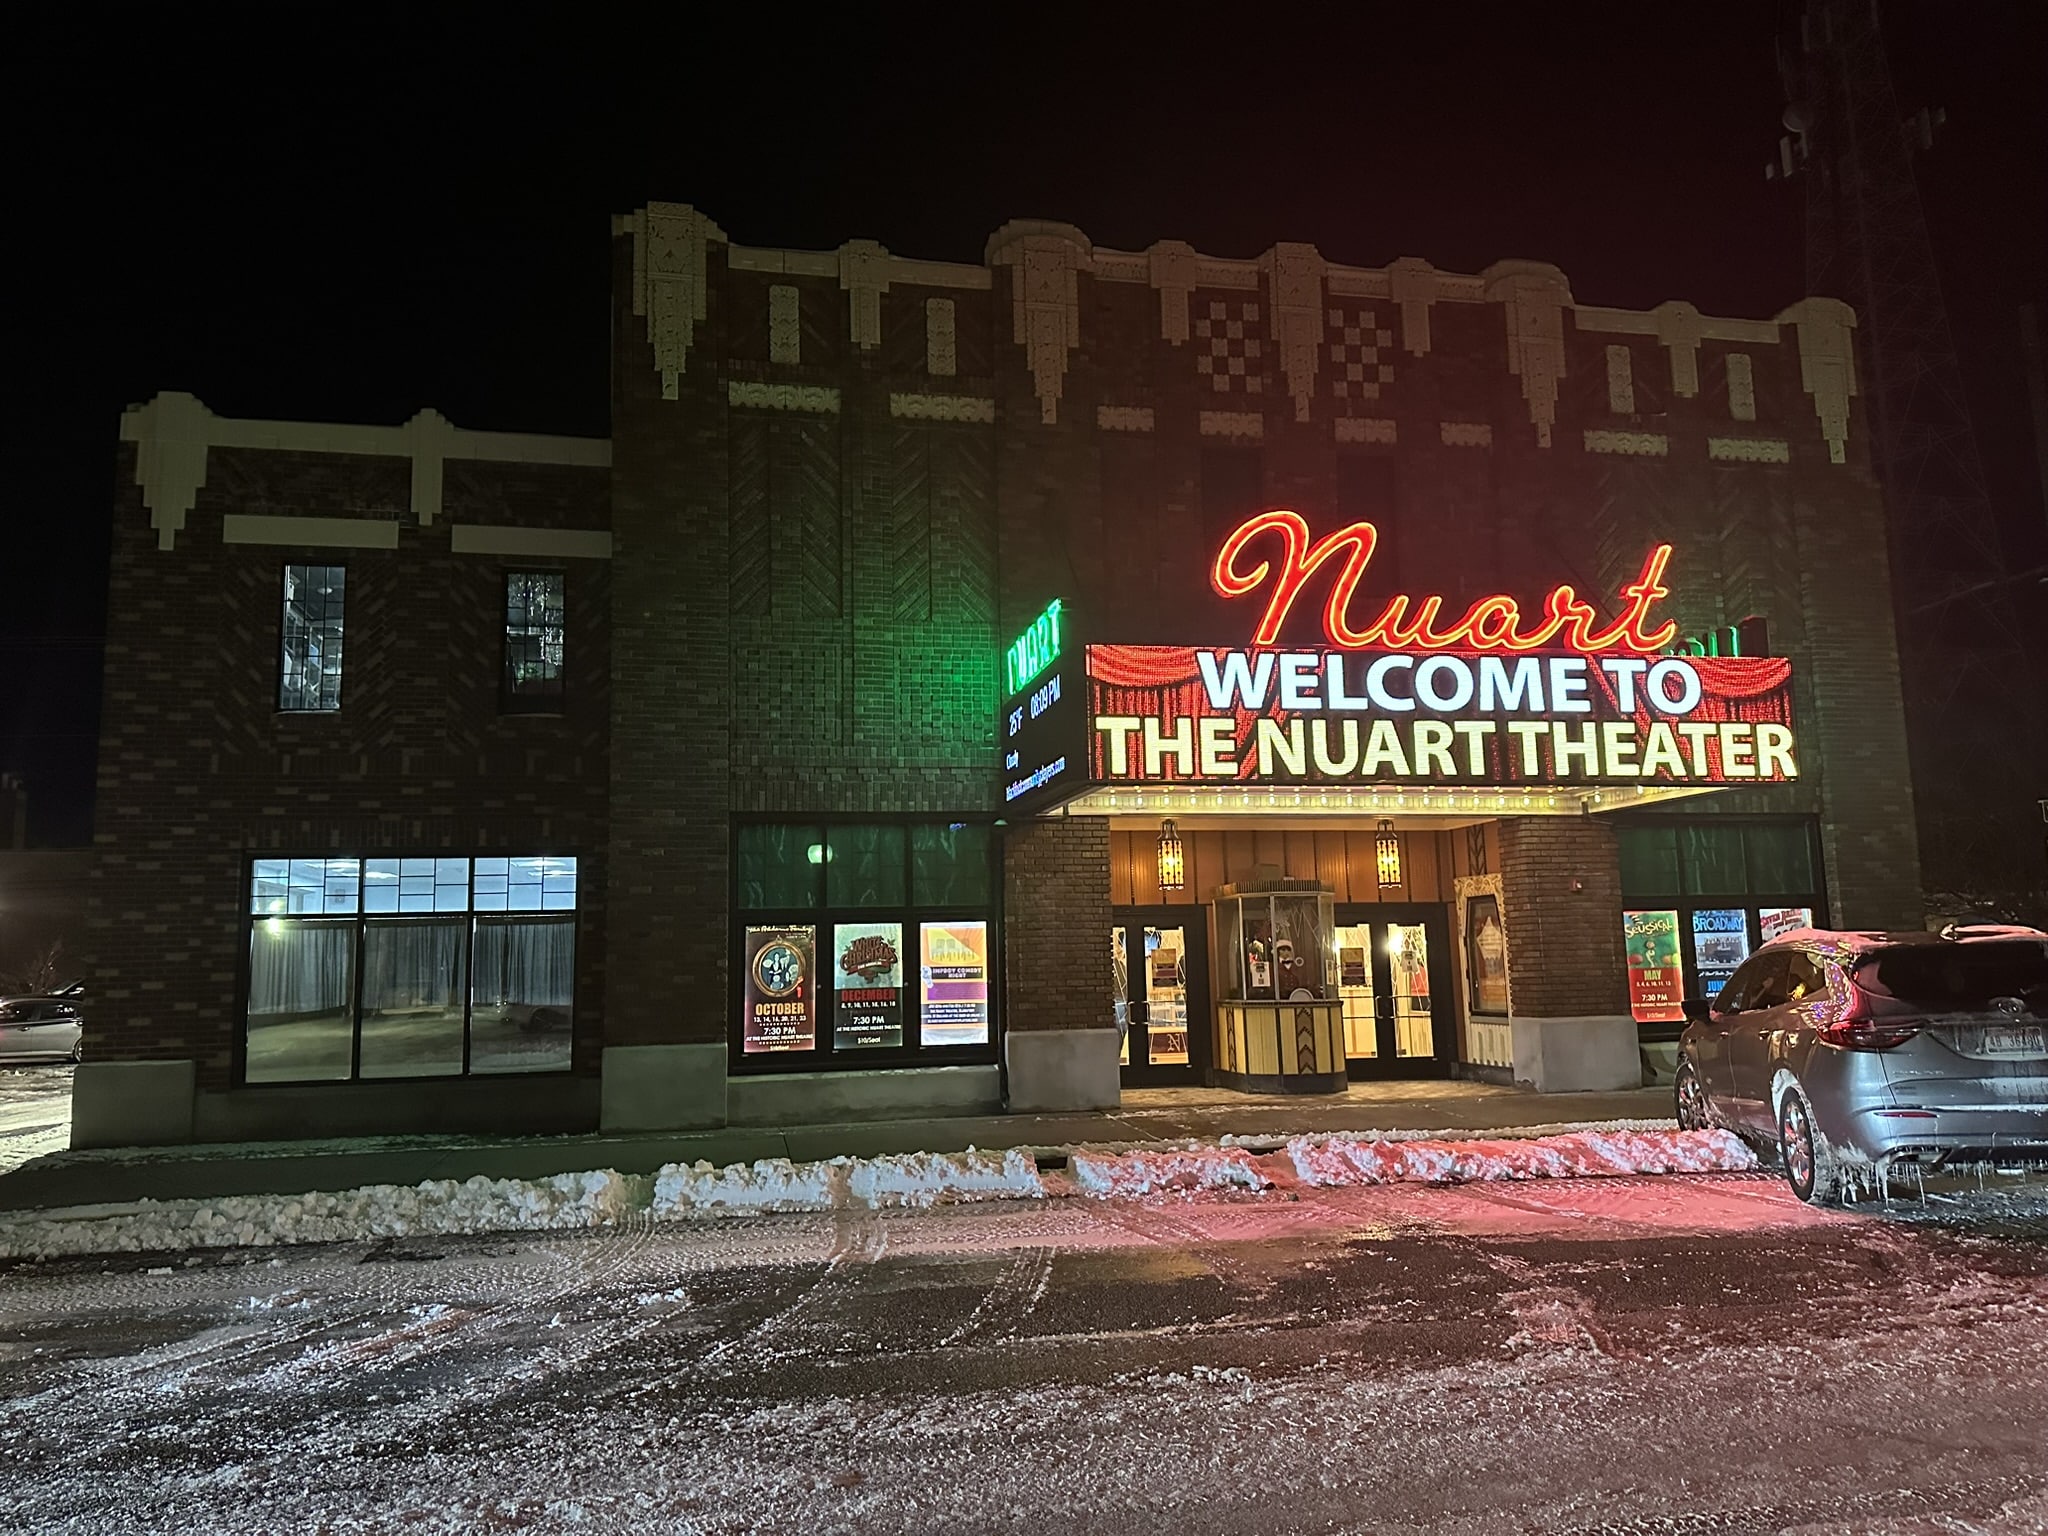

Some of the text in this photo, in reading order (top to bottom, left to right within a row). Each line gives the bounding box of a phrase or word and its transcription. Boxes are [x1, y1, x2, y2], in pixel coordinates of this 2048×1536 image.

[1211, 510, 1677, 652] Nuart
[1048, 674, 1061, 706] PM
[1197, 651, 1702, 716] WELCOME TO
[1095, 716, 1798, 778] THE NUART THEATER
[1692, 916, 1743, 932] BROADWAY
[1643, 969, 1662, 981] MAY
[1707, 980, 1727, 992] JUN
[841, 988, 896, 1002] DECEMBER
[1641, 993, 1668, 1002] 7:30 PM
[755, 1002, 805, 1016] OCTOBER
[853, 1015, 885, 1025] 7:30 PM
[763, 1026, 796, 1036] 7:30 PM
